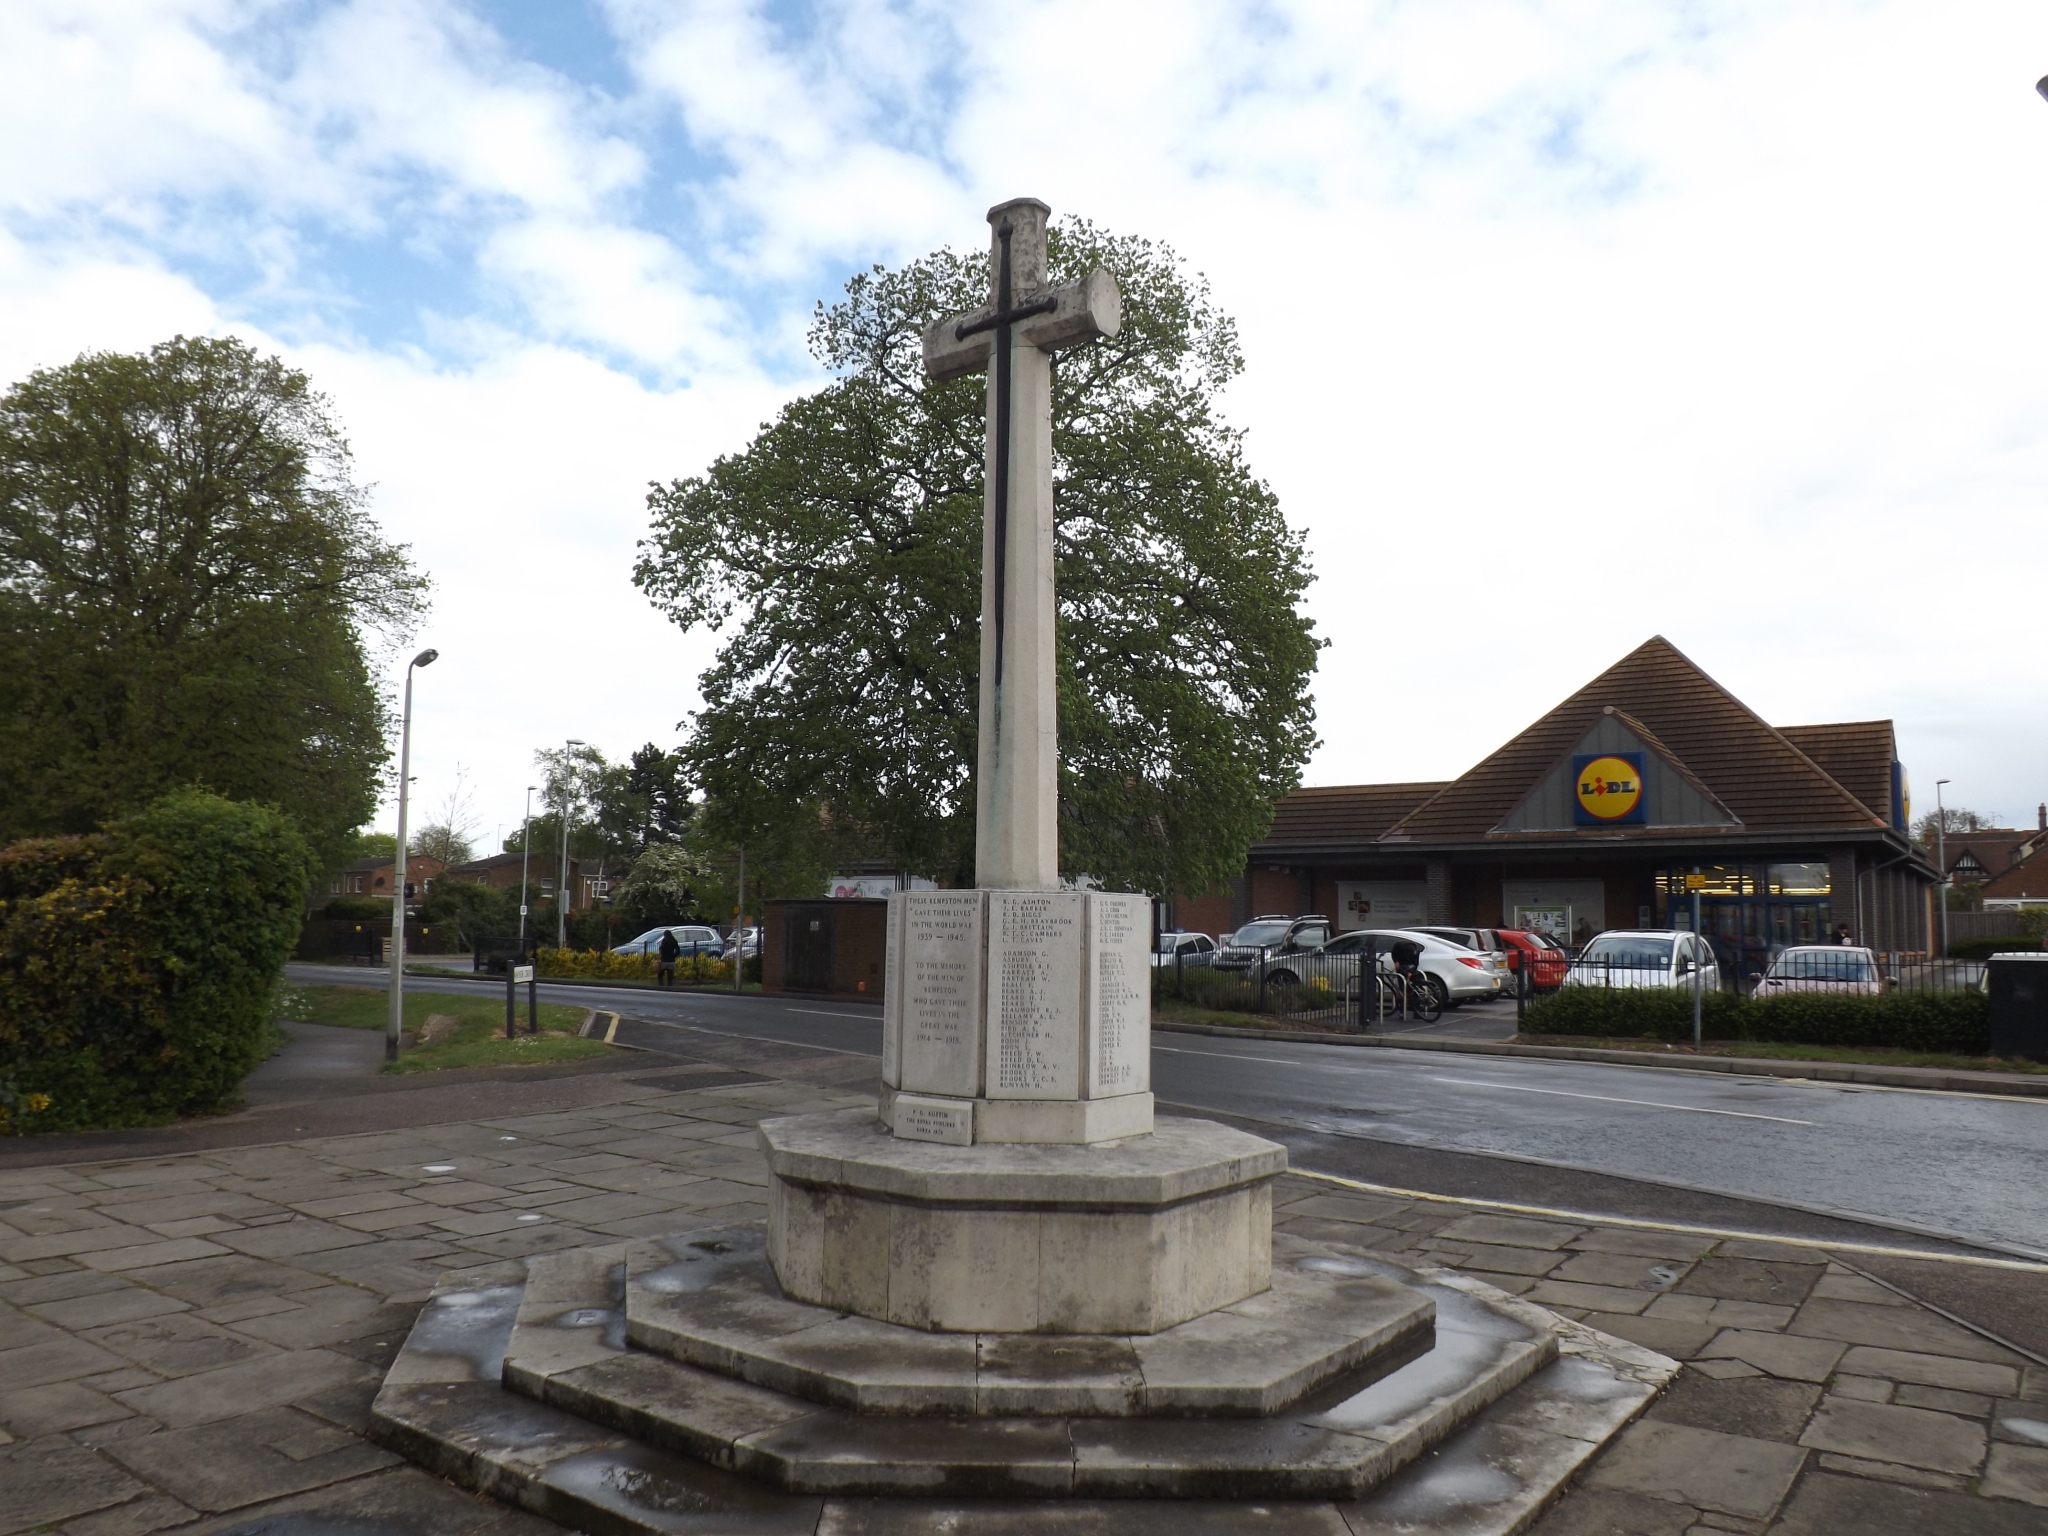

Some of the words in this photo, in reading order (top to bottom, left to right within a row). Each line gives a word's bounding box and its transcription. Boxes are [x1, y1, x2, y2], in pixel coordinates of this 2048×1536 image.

[1581, 777, 1635, 796] LIDL
[917, 933, 933, 941] 1939
[917, 1034, 931, 1042] 1914
